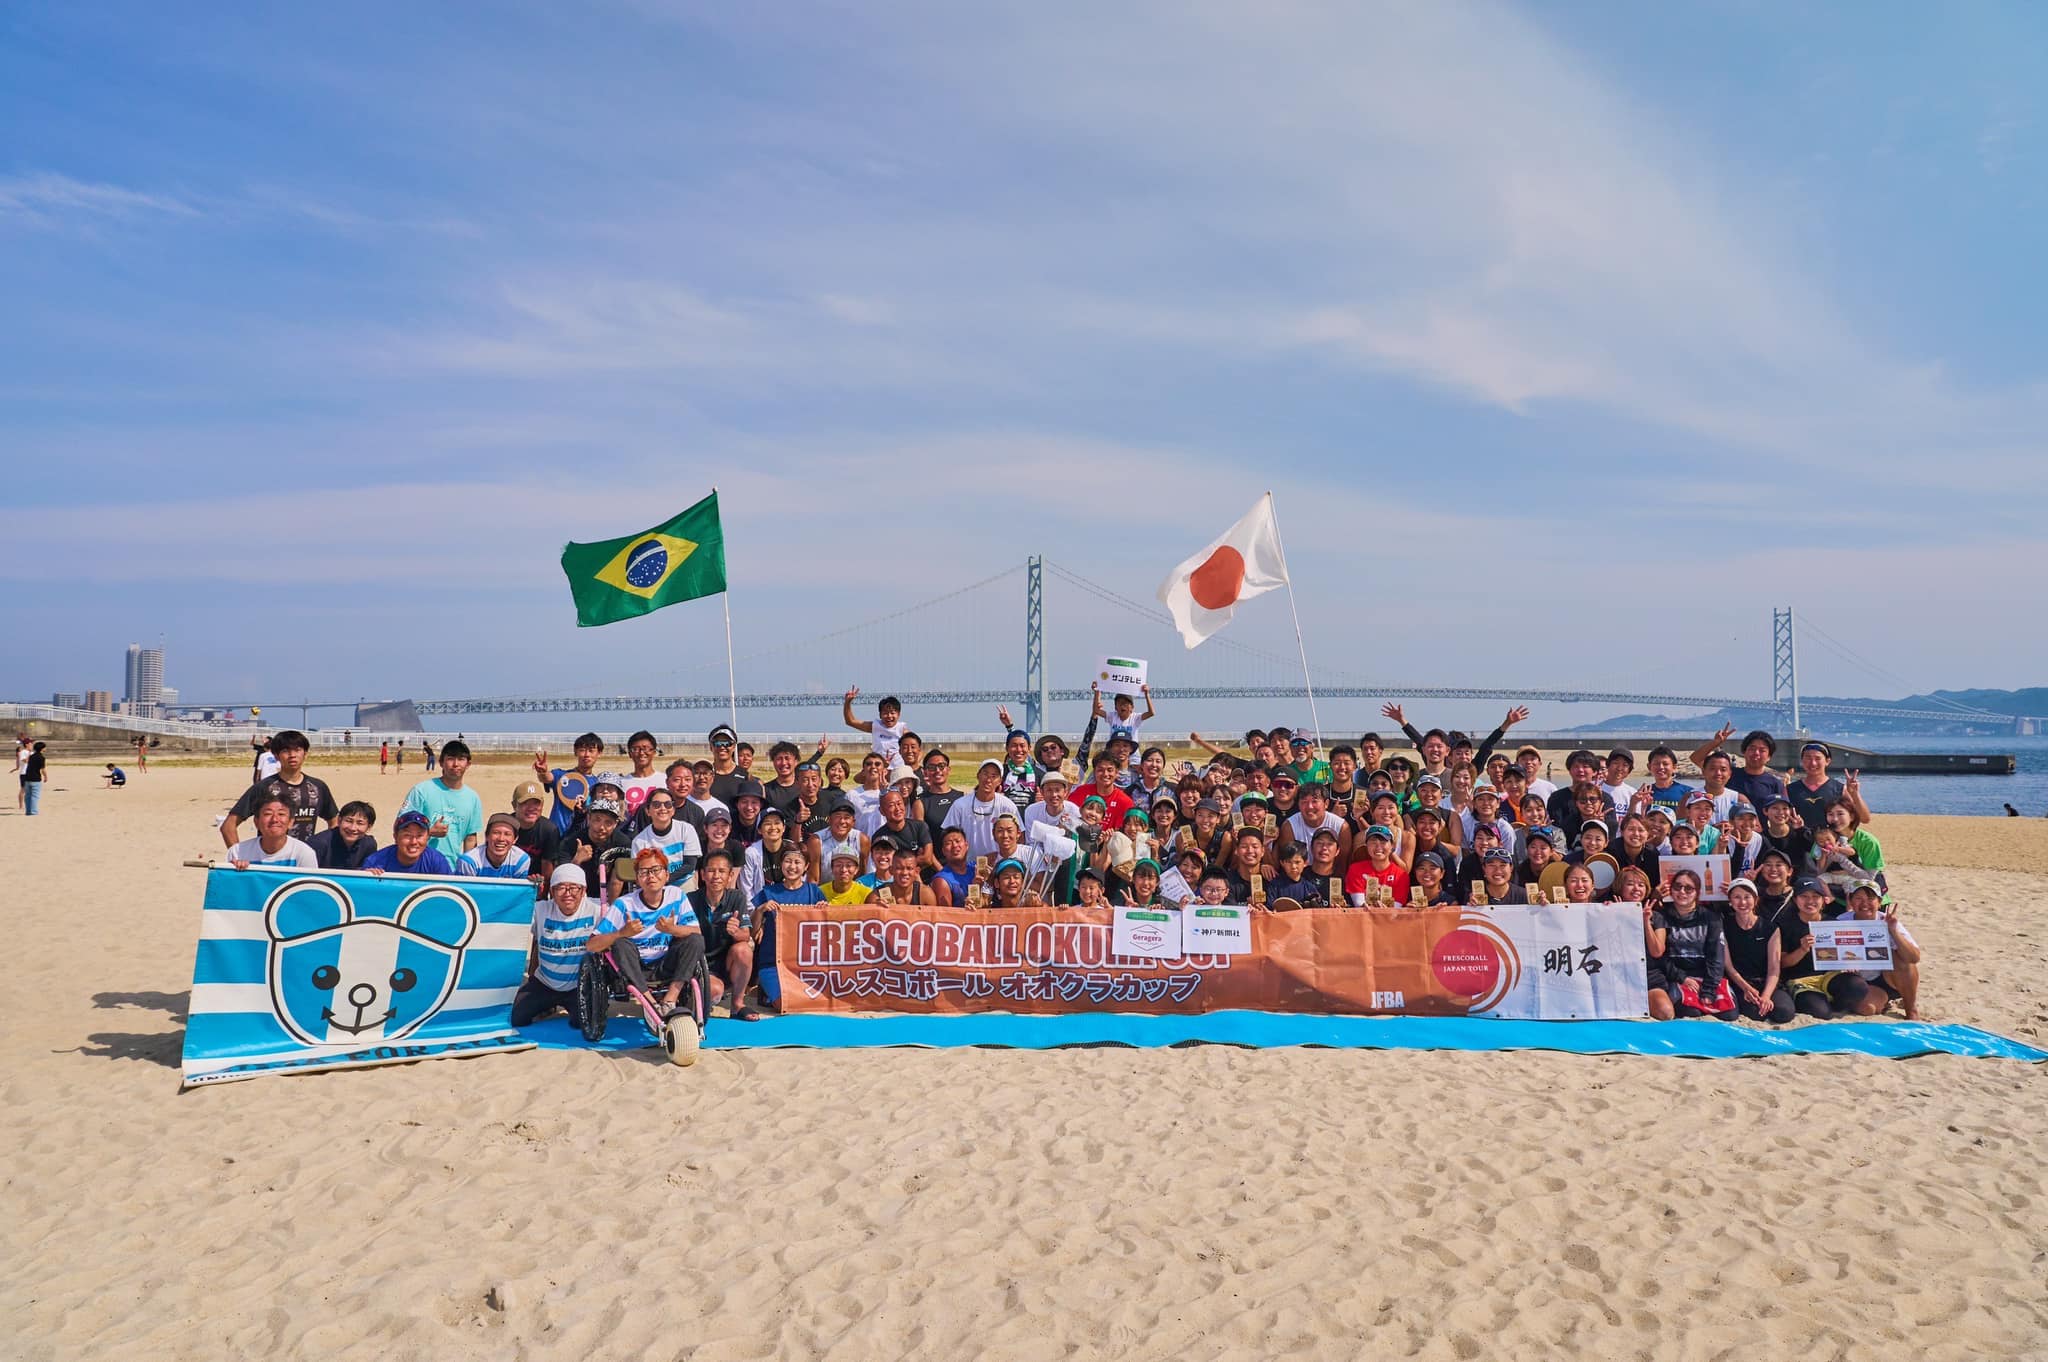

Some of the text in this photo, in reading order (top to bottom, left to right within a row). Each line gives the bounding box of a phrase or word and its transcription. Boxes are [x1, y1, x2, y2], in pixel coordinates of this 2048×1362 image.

[1132, 933, 1162, 943] Geragera
[1200, 927, 1241, 938] 神戸新聞社
[798, 919, 1157, 968] FRESCOBALL OKU
[1442, 954, 1489, 962] FRESCOBALL
[1543, 944, 1604, 977] 明石
[1443, 964, 1489, 973] JAPAN TOUR
[800, 968, 1201, 1003] フレスコボール オオクラカップ
